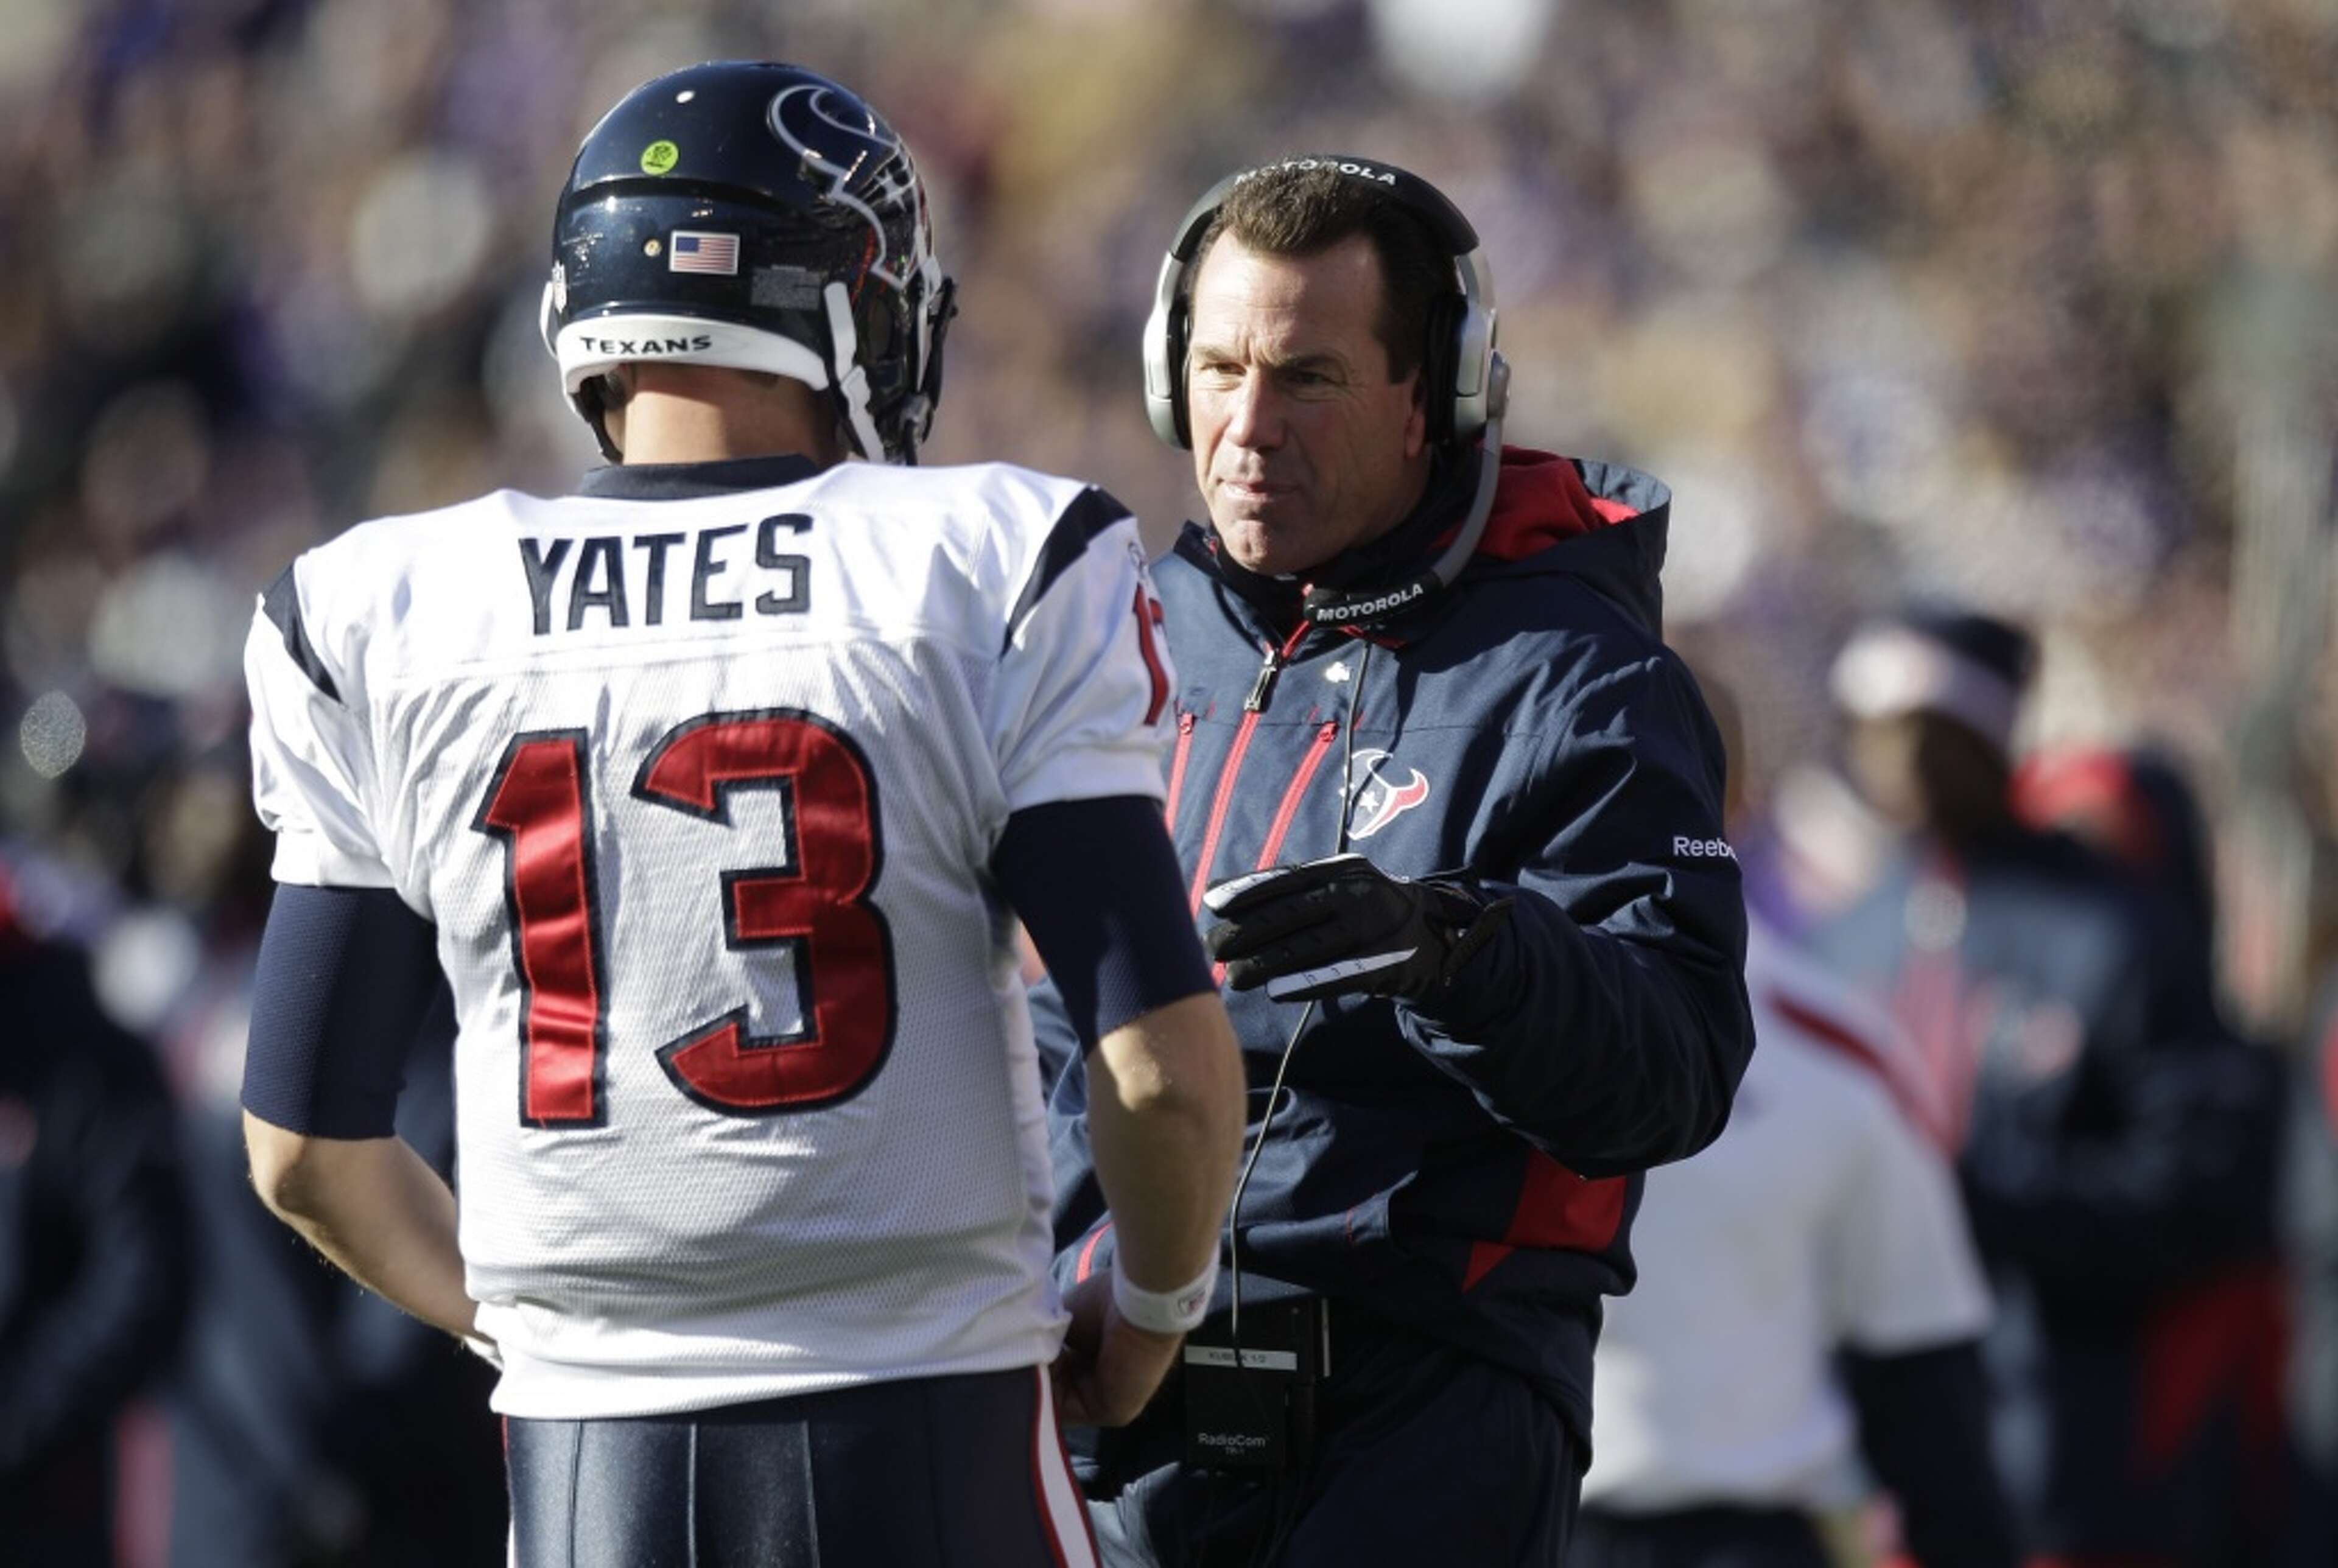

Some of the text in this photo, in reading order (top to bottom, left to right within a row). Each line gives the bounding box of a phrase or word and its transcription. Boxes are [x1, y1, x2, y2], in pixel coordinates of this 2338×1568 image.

[580, 335, 712, 354] TEXANS
[518, 513, 814, 636] YATES
[1317, 583, 1424, 621] MOTOROLA
[470, 707, 897, 1128] 13
[1198, 1433, 1266, 1447] RadioCom
